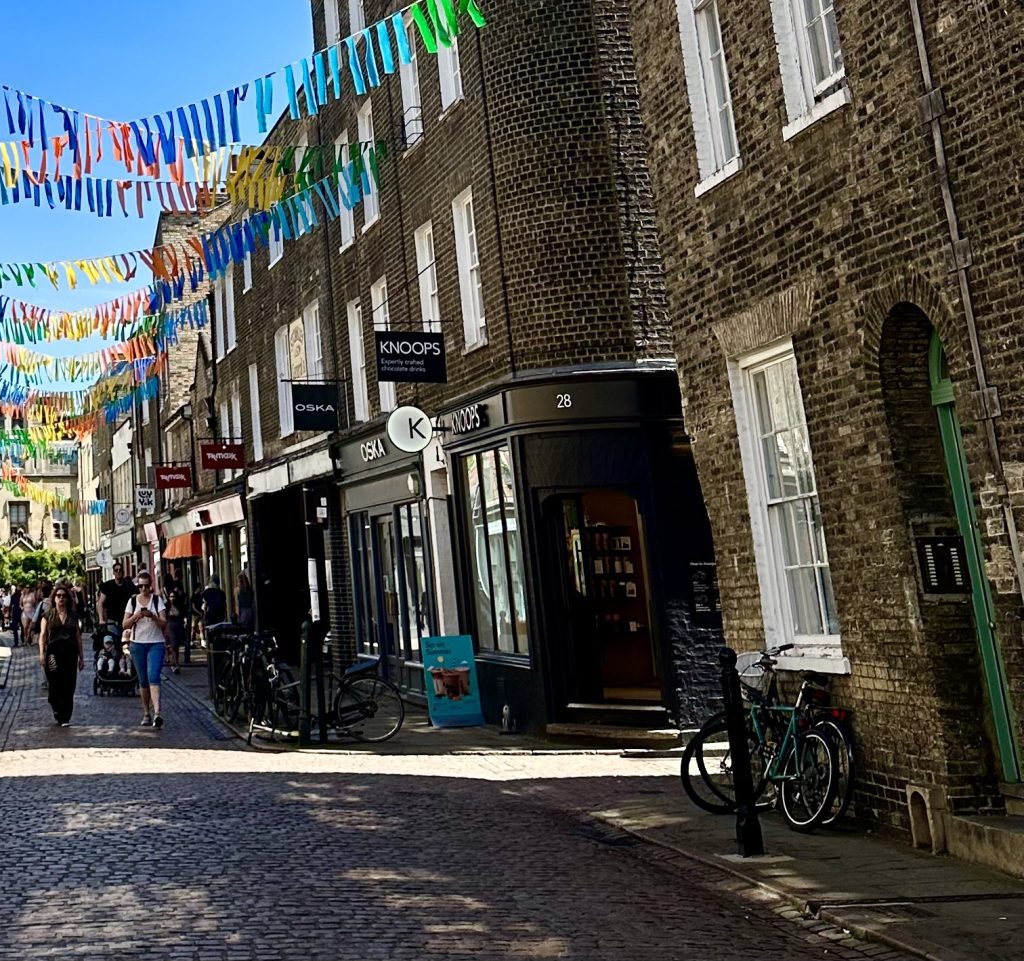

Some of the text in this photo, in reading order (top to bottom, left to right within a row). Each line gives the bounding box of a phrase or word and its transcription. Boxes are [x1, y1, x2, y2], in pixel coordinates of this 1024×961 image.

[380, 341, 441, 355] KNOOPS
[381, 358, 403, 366] Expertly
[295, 404, 334, 412] OSKA
[556, 394, 572, 408] 28
[451, 406, 481, 435] KNOOPS
[408, 418, 426, 439] K
[360, 438, 386, 462] OSKA
